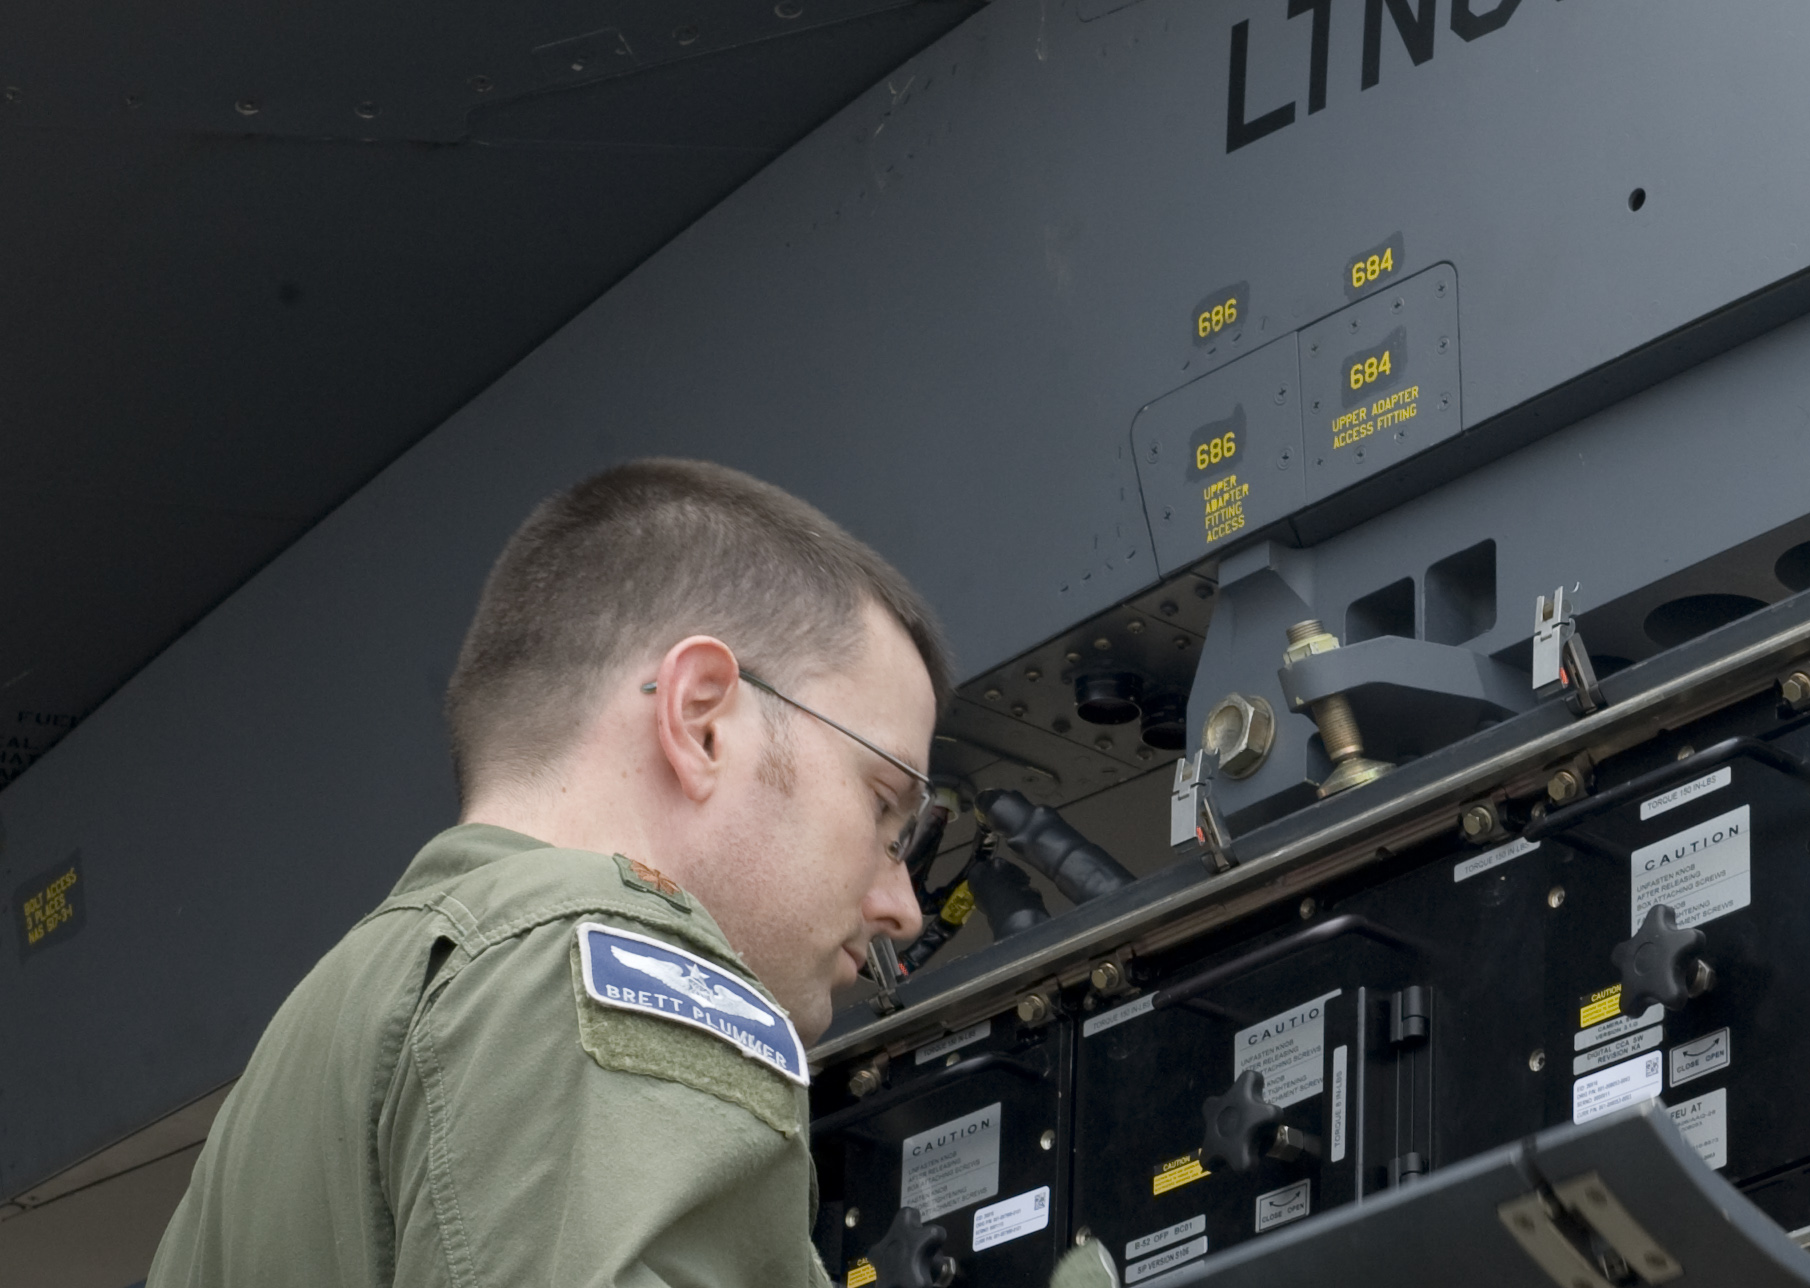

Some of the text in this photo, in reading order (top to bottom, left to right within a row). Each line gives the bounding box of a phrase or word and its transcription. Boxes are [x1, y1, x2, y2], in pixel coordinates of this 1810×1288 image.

[1352, 247, 1393, 288] 684
[1198, 298, 1237, 337] 686
[1350, 350, 1391, 390] 684
[1332, 385, 1419, 432] UPPER ADAPTER
[1333, 403, 1417, 450] ACCESS FITTING
[1196, 431, 1236, 470] 686
[1203, 474, 1237, 500] UPPER
[1205, 483, 1249, 515] ADAPTER
[1205, 501, 1242, 529] FITTING
[1206, 515, 1245, 543] ACCESS
[1647, 775, 1717, 810] TORQUE 150 IN-LBS
[1645, 824, 1739, 871] CAUTION
[1465, 857, 1493, 875] TORQUE
[1637, 863, 1696, 892] UNFASTEN KNOB
[24, 867, 78, 916] BOLT ACCESS
[1637, 871, 1702, 902] AFTER RELEASING
[1654, 885, 1694, 906] ATTACHING
[1695, 869, 1727, 887] SCREWS
[35, 893, 66, 924] PLACES
[1702, 899, 1734, 917] SCREWS
[1591, 983, 1622, 1003] CAUTION
[605, 984, 788, 1069] BRETT PLUMMER
[1248, 1008, 1320, 1046] CAUTIO
[1241, 1038, 1294, 1066] UNFASTEN KNOB
[1262, 1046, 1299, 1067] RELEASING
[1293, 1044, 1321, 1062] SCREWS
[1587, 1045, 1612, 1061] DIGITAL
[1632, 1034, 1644, 1044] SW
[1597, 1048, 1628, 1064] REVISION
[1676, 1049, 1725, 1073] CLOSE OPEN
[1266, 1074, 1285, 1088] KNOB
[1299, 1077, 1323, 1093] SCREW
[1691, 1102, 1703, 1114] AT
[913, 1118, 990, 1157] CAUTION
[1334, 1109, 1342, 1148] TORQUE
[1163, 1155, 1191, 1172] CAUTION
[1261, 1201, 1305, 1224] CLOSE OPEN
[1149, 1251, 1174, 1271] VERSION
